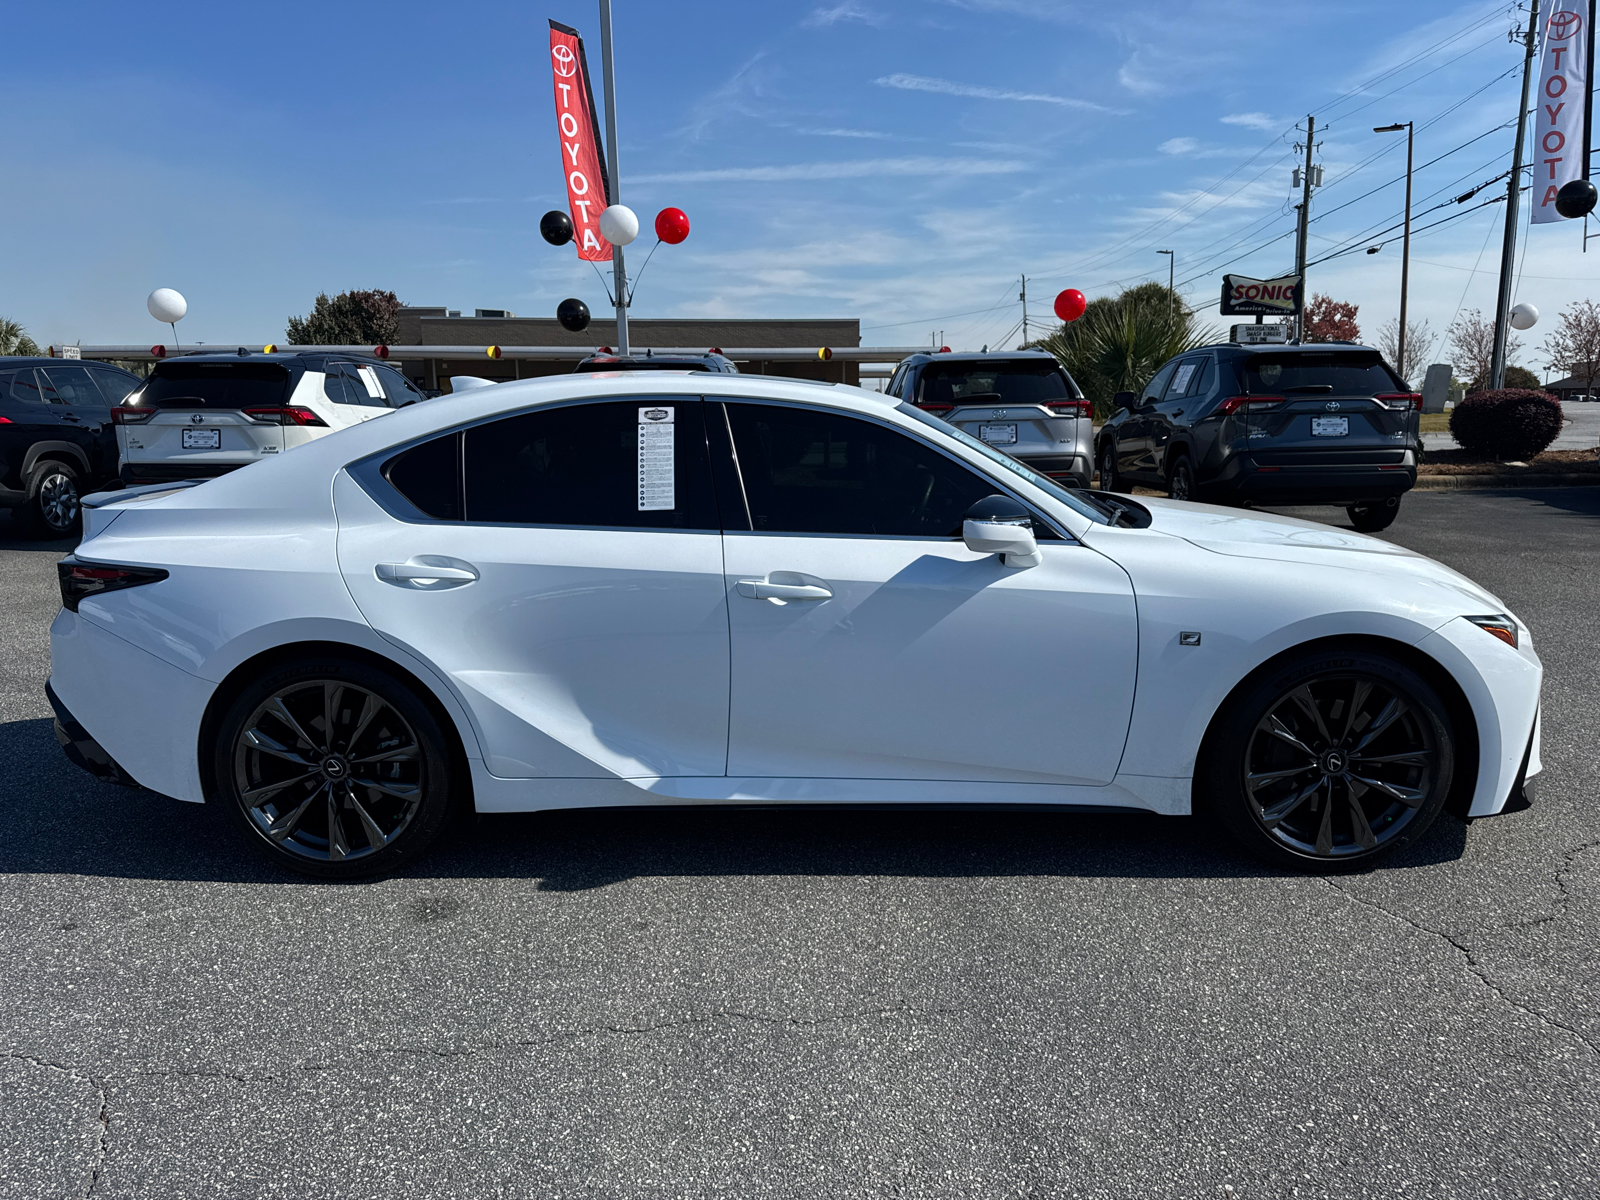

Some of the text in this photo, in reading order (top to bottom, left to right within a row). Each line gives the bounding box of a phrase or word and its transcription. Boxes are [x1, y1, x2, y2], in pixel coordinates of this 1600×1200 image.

[1541, 47, 1567, 207] TOYOTA
[558, 83, 601, 251] TOYOTA
[1233, 284, 1295, 300] SONIC
[276, 665, 337, 682] MICHELIN
[1289, 659, 1352, 681] MICHELIN
